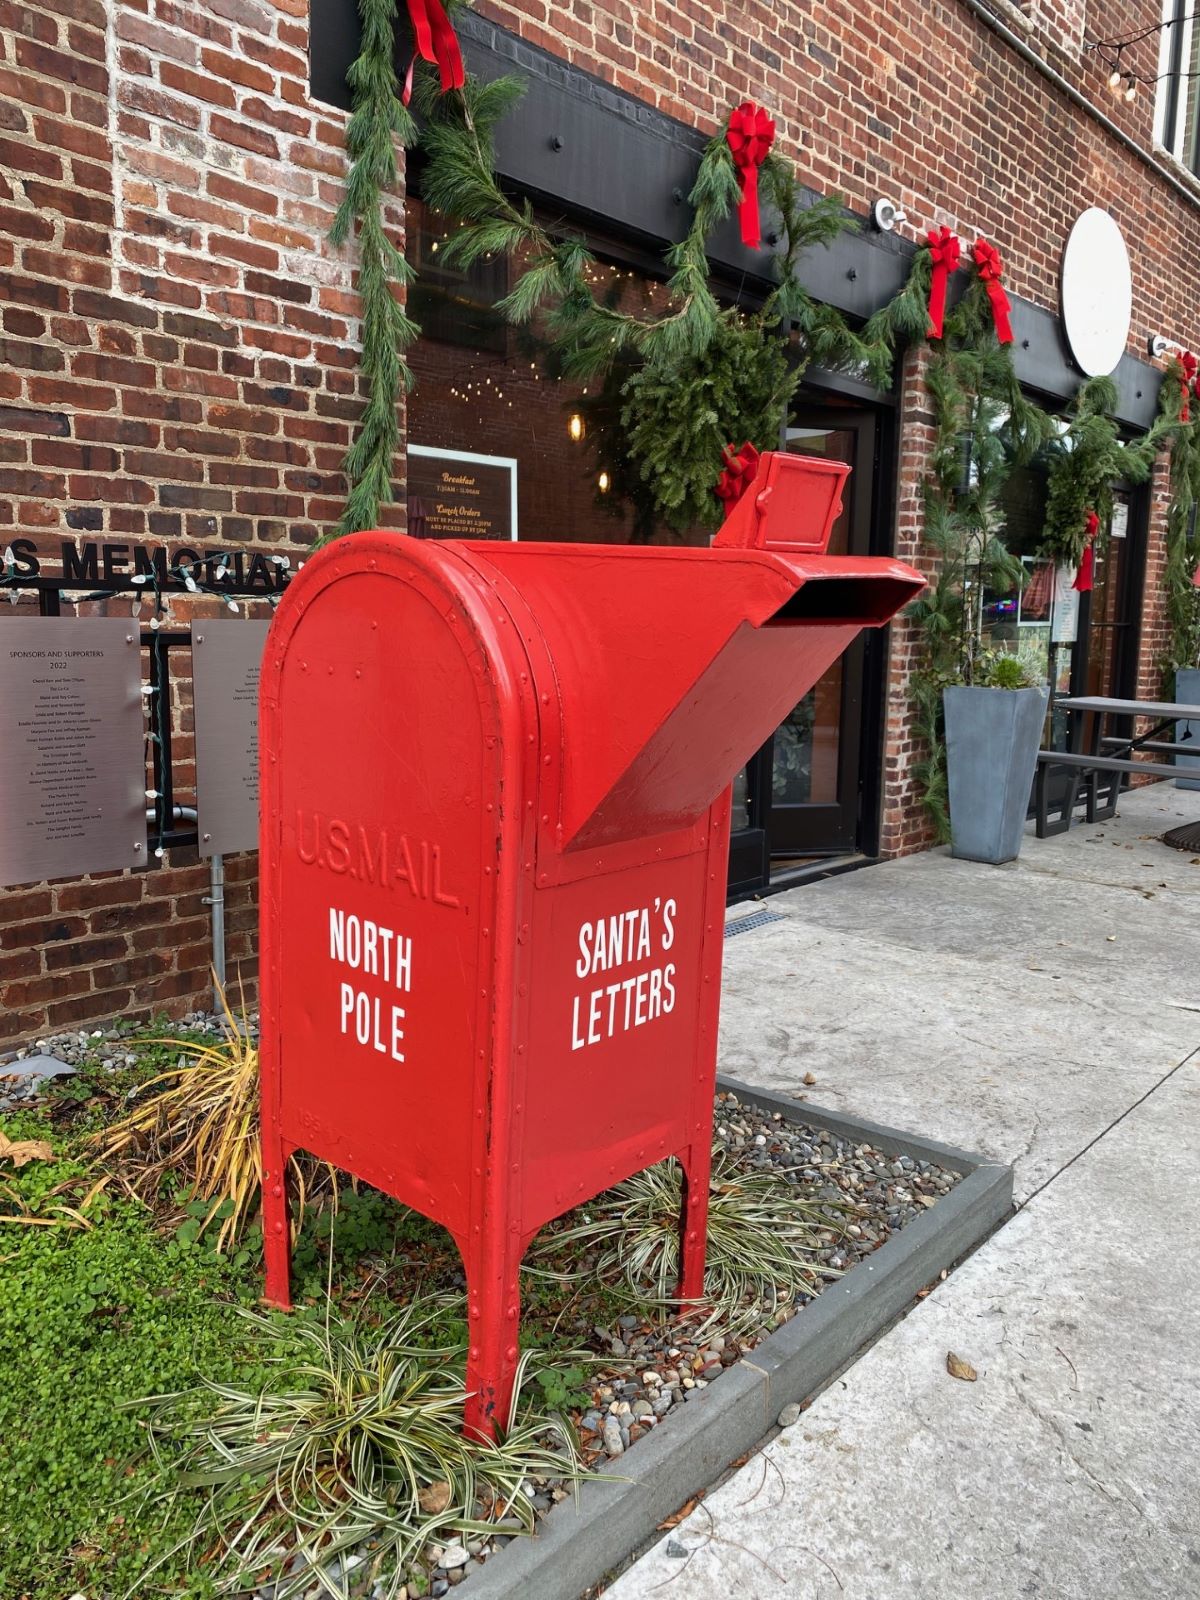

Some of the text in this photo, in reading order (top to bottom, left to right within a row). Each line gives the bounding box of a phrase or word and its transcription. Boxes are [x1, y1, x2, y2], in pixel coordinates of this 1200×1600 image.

[436, 504, 481, 517] Lunch Orders
[442, 472, 475, 485] Breakfast
[329, 907, 412, 993] NORTH
[576, 896, 677, 979] SANTA'S
[340, 982, 406, 1063] POLE
[571, 963, 676, 1051] LETTERS
